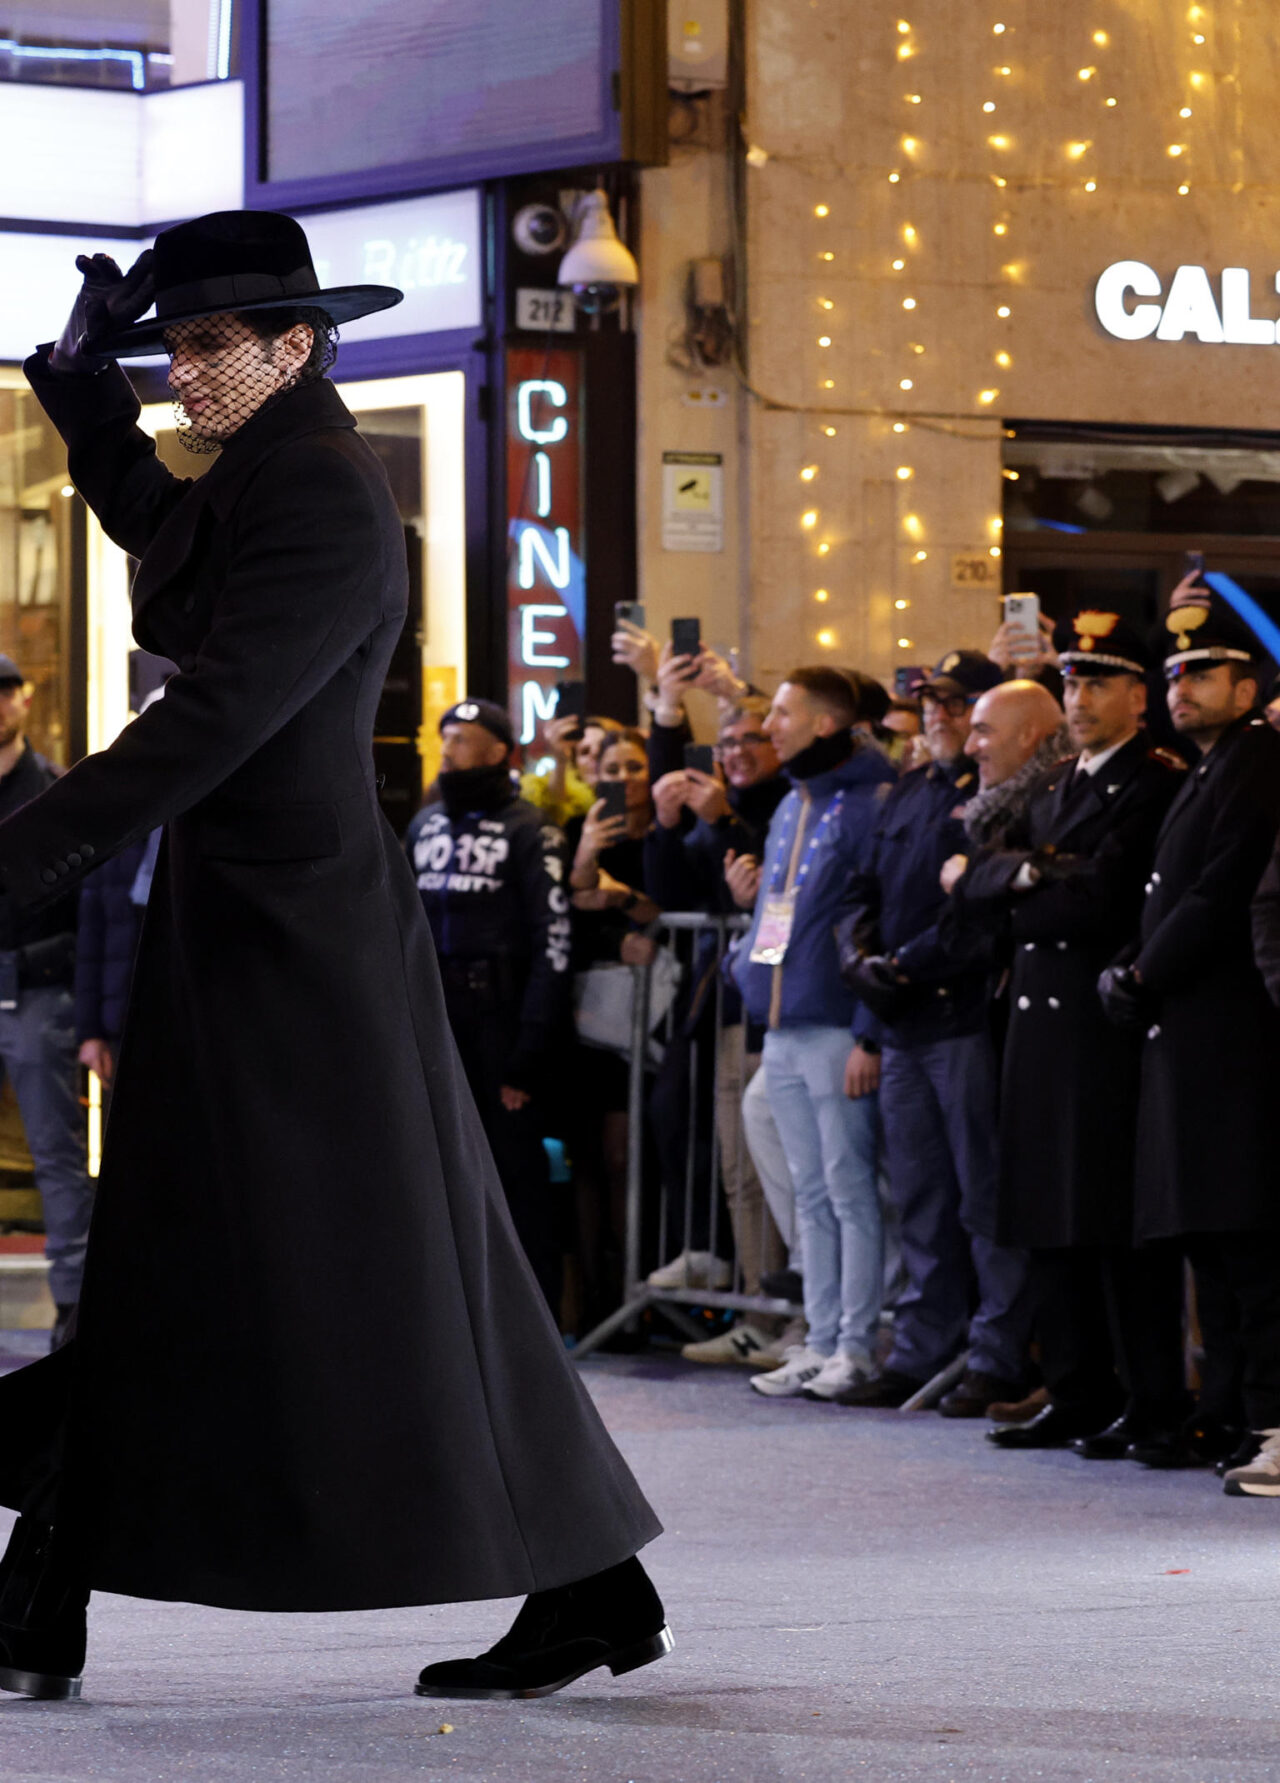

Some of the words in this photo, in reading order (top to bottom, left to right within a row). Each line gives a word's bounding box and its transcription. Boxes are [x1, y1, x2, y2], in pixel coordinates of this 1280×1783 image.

[528, 298, 565, 323] 212
[1095, 260, 1280, 345] CAL
[517, 379, 570, 776] CINEM
